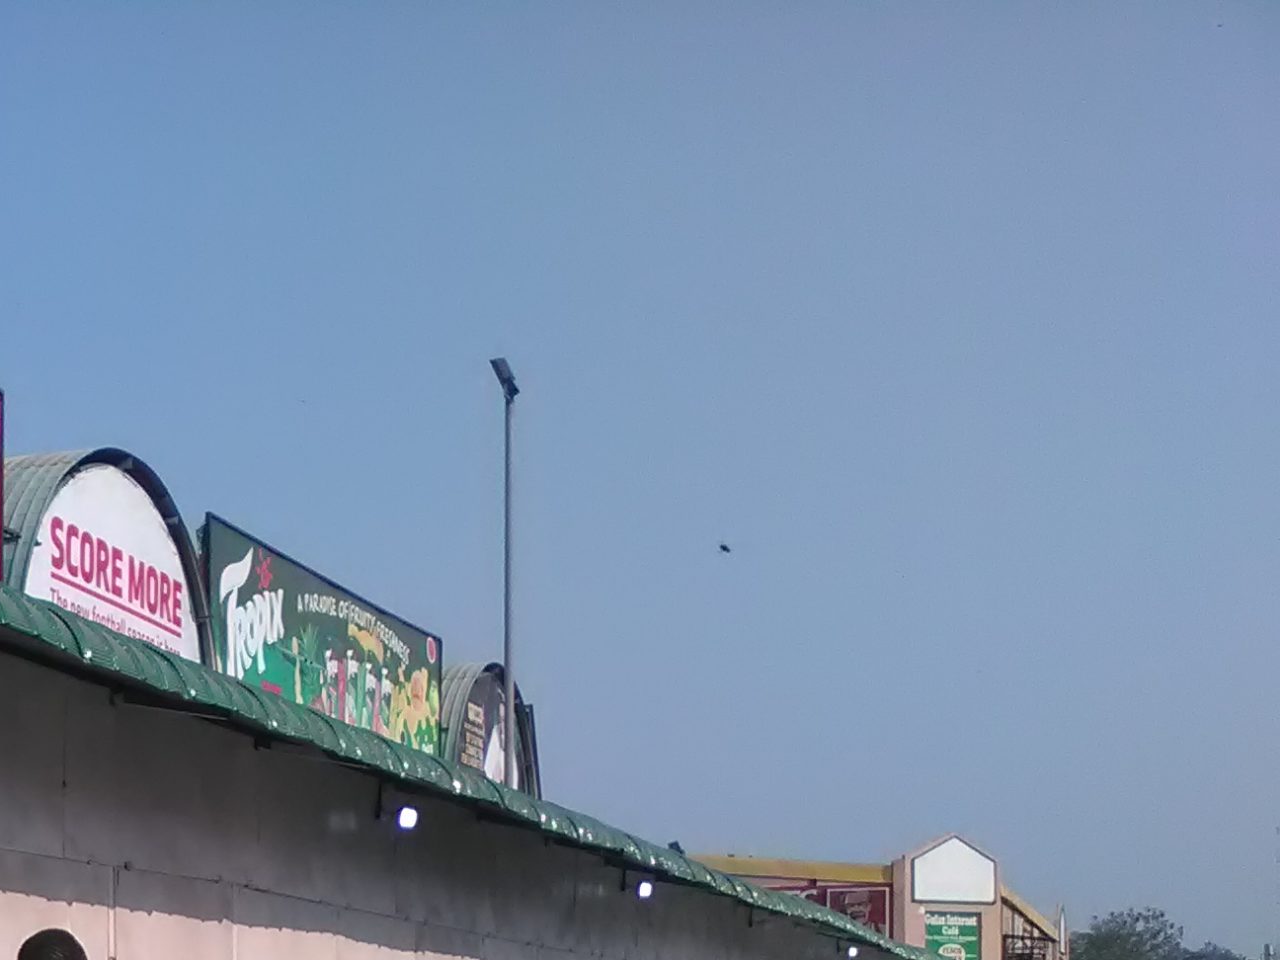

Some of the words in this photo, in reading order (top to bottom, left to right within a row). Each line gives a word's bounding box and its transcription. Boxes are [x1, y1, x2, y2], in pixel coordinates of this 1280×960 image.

[50, 516, 123, 599] SCORE
[127, 554, 183, 628] MORE
[304, 592, 337, 617] PARADISE
[338, 599, 349, 620] OF
